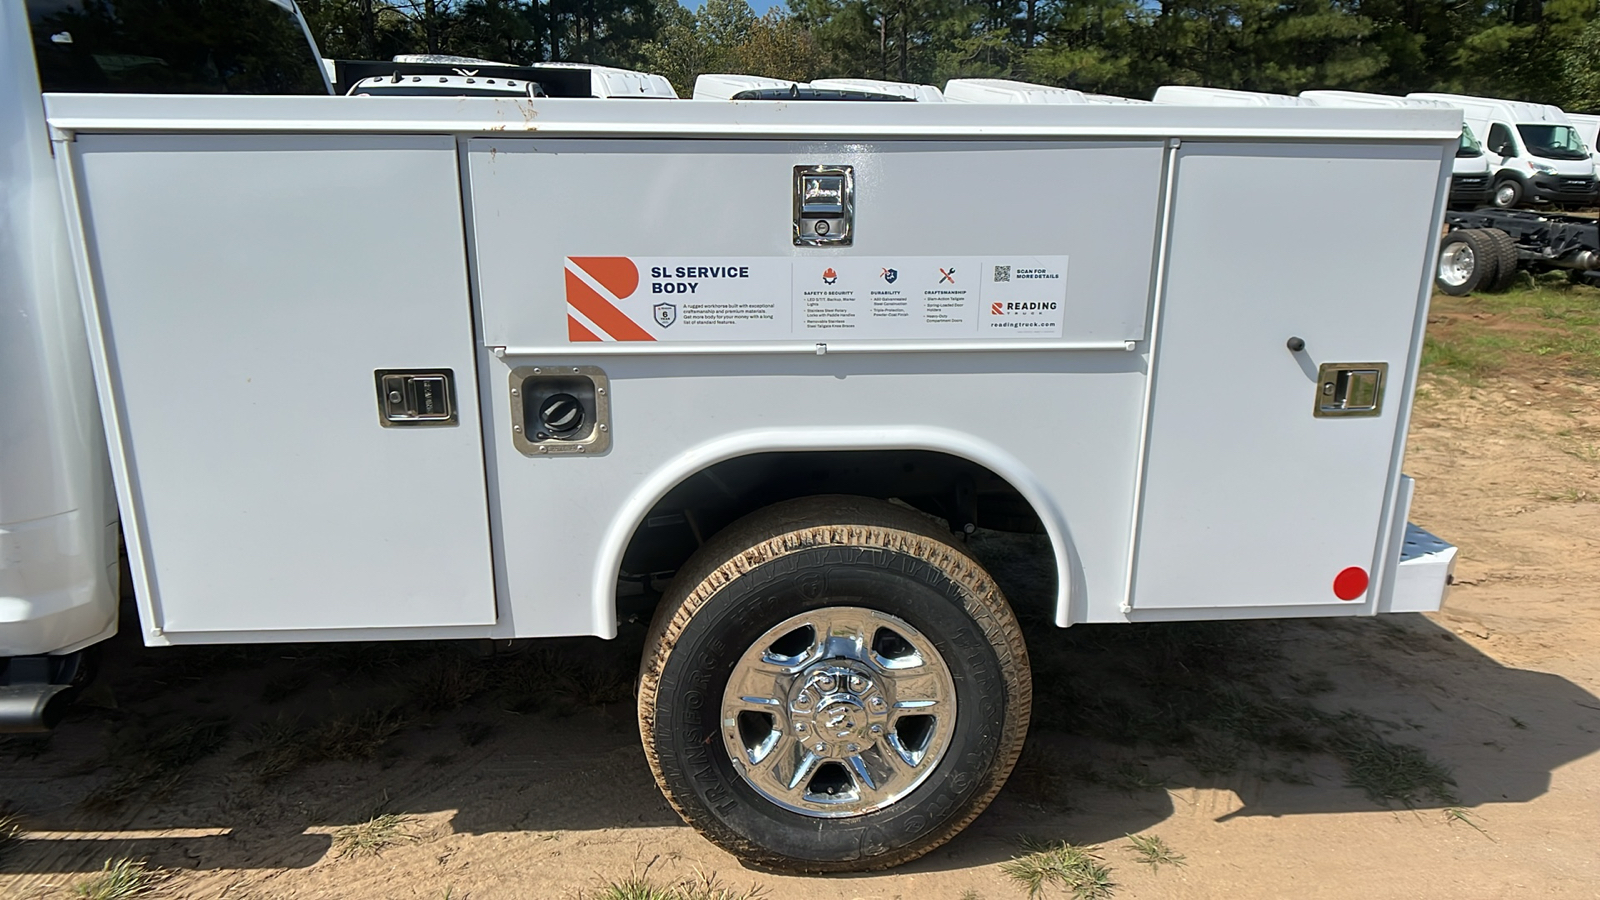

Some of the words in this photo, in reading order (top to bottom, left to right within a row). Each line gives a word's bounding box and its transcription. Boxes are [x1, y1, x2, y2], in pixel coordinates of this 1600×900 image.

[651, 267, 672, 278] SL
[675, 267, 749, 278] SERVICE
[652, 283, 699, 293] BODY
[1007, 302, 1057, 310] READING
[682, 635, 739, 818] TRANSFORCE
